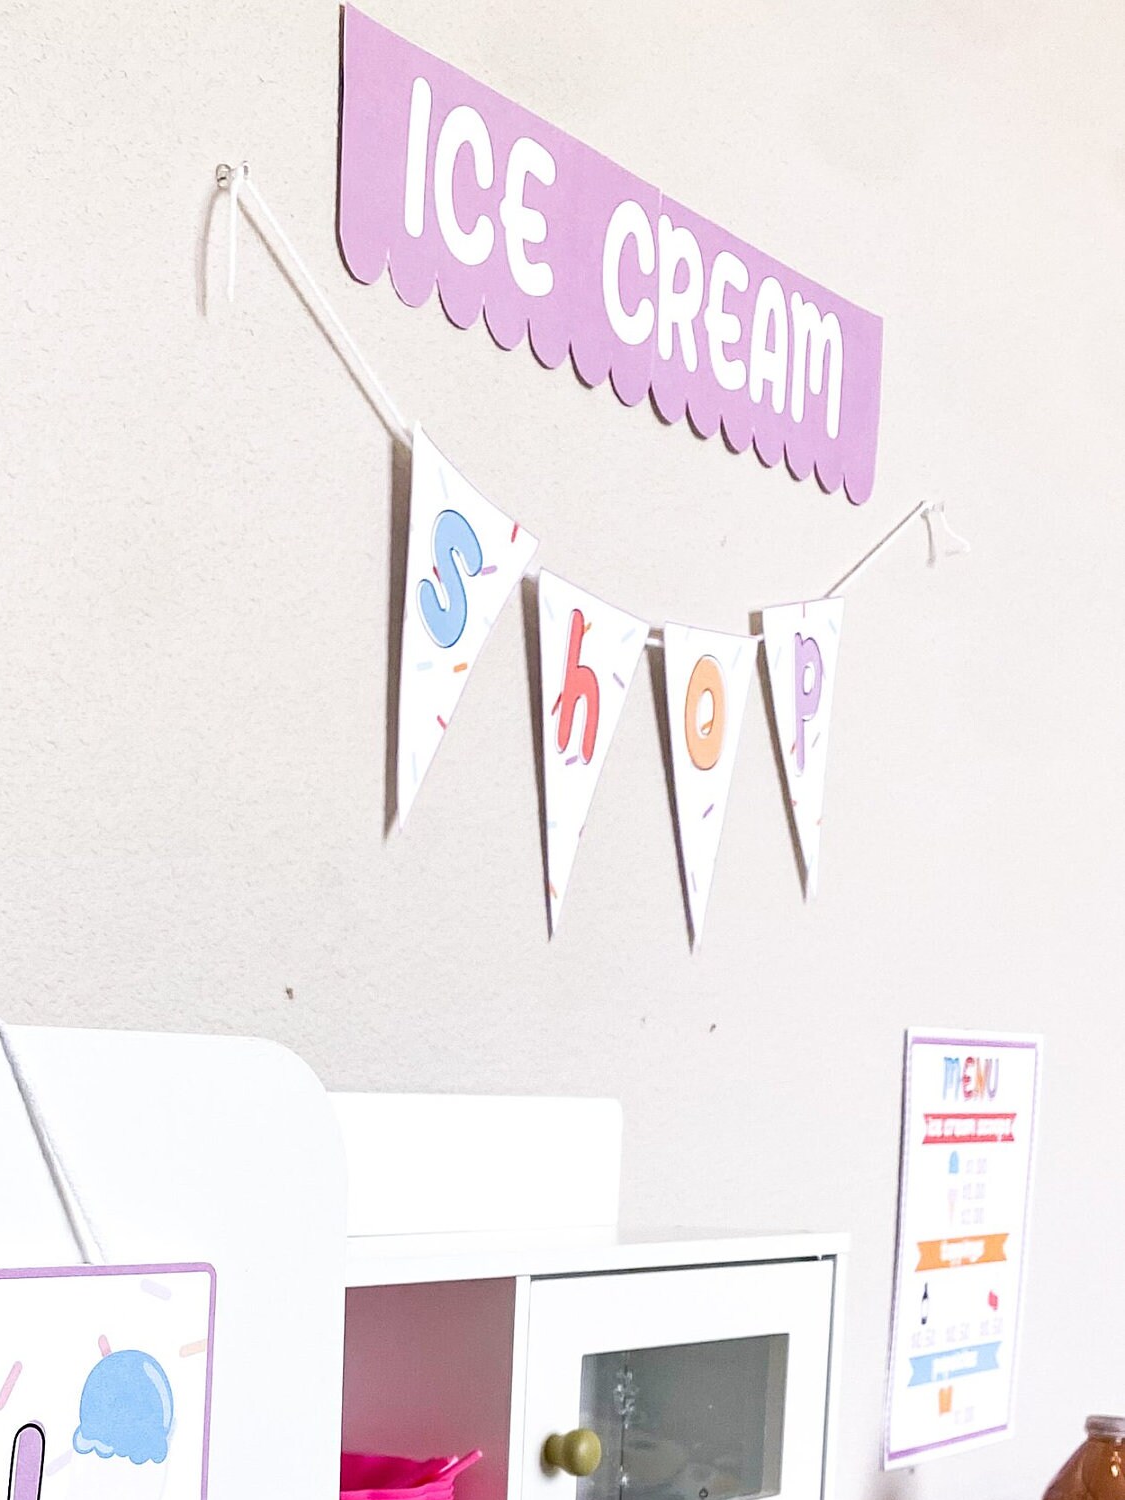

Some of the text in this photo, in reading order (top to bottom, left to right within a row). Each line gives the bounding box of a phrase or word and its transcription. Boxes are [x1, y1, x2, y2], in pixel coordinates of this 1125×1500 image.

[403, 76, 844, 440] ICE CREAM
[942, 1056, 1000, 1101] MENU
